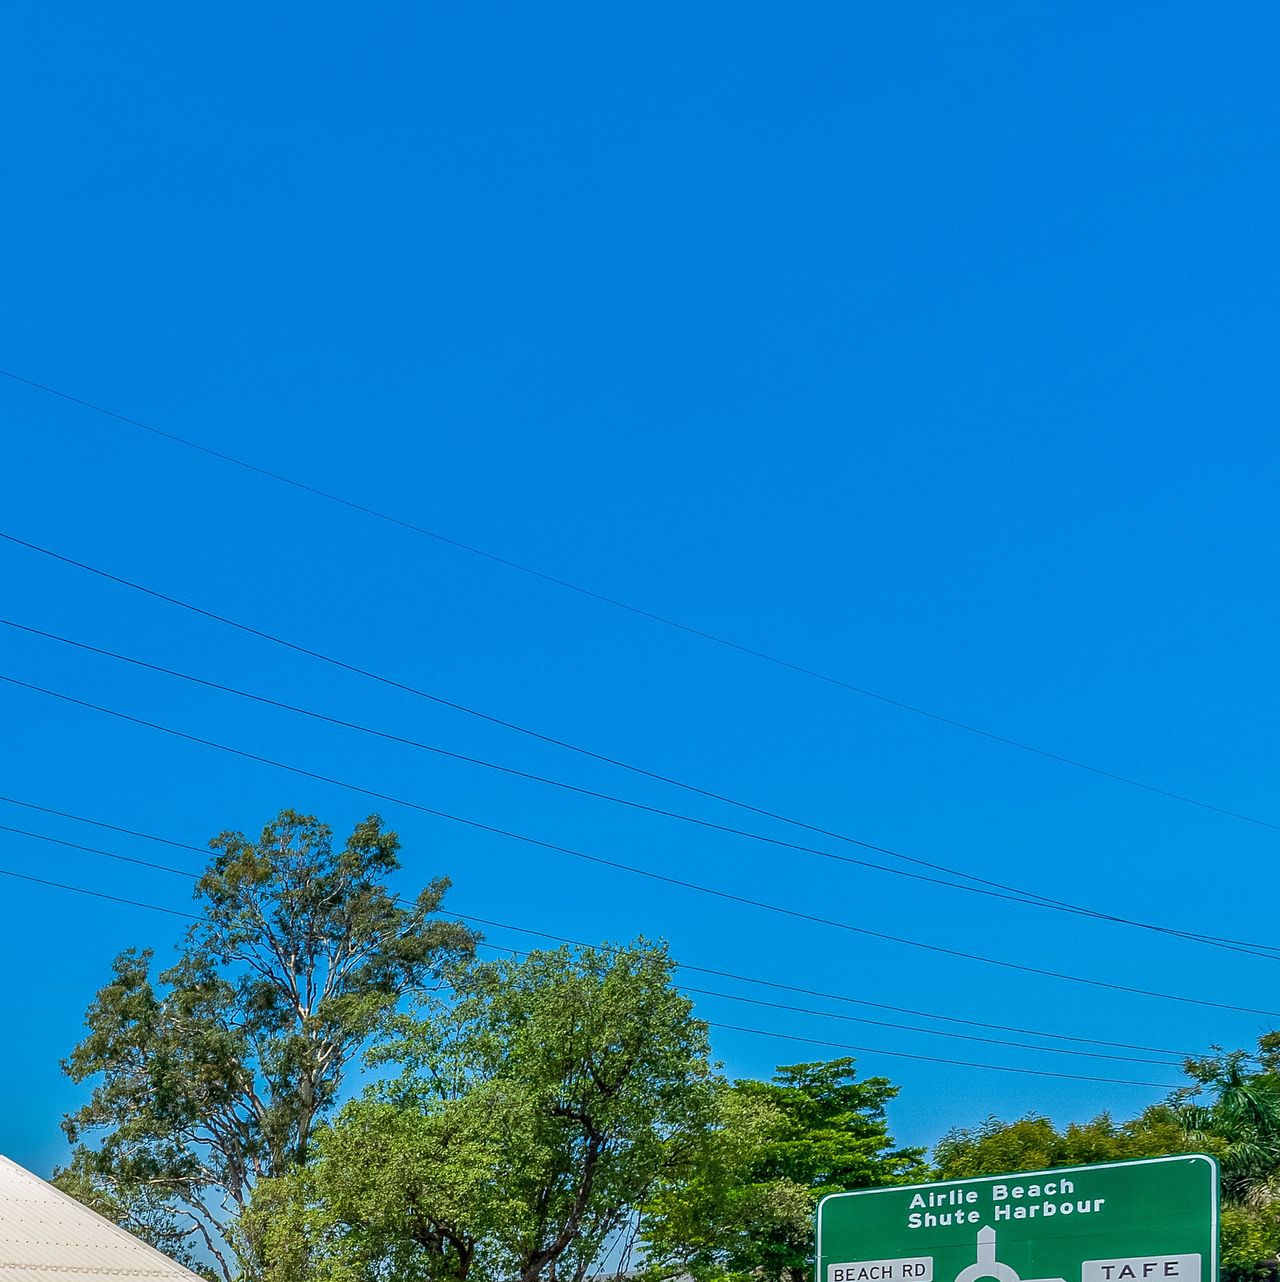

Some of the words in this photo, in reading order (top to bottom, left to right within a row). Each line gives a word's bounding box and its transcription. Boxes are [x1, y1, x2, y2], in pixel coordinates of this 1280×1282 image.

[908, 1189, 978, 1210] Airlie
[991, 1178, 1075, 1201] Beach
[907, 1208, 980, 1229] Shute
[993, 1197, 1105, 1222] Harbour
[833, 1266, 893, 1282] BEACH
[901, 1263, 927, 1277] RD
[1101, 1261, 1180, 1281] TAFE
